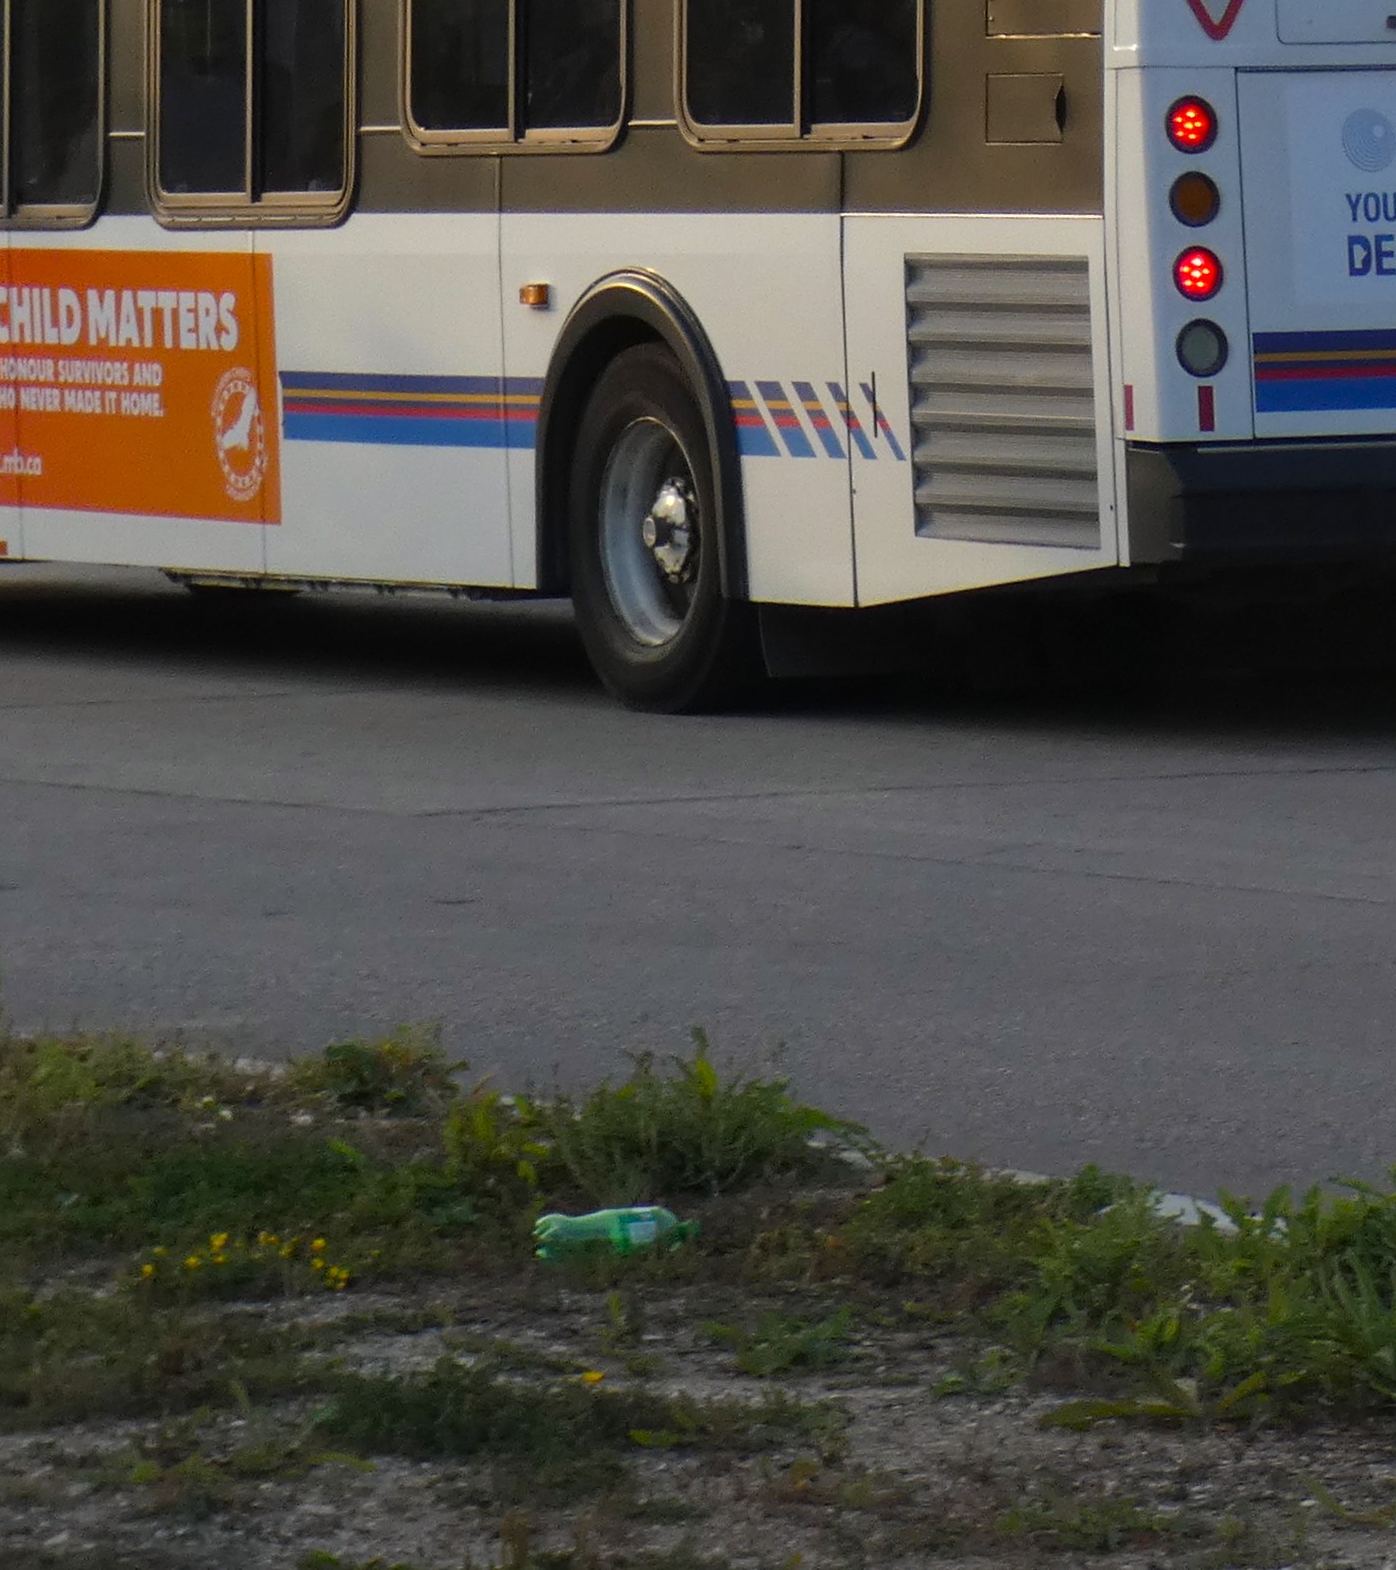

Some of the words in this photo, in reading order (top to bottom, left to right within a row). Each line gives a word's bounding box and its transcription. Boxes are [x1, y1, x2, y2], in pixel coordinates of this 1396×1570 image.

[87, 289, 238, 351] MATTERS
[0, 357, 55, 381] HONOUR
[58, 359, 129, 385] SURVIVORS
[133, 362, 163, 386] AND
[20, 387, 61, 412] NEVER
[64, 389, 102, 413] MADE
[105, 391, 117, 414] IT
[121, 392, 165, 417] HOME.
